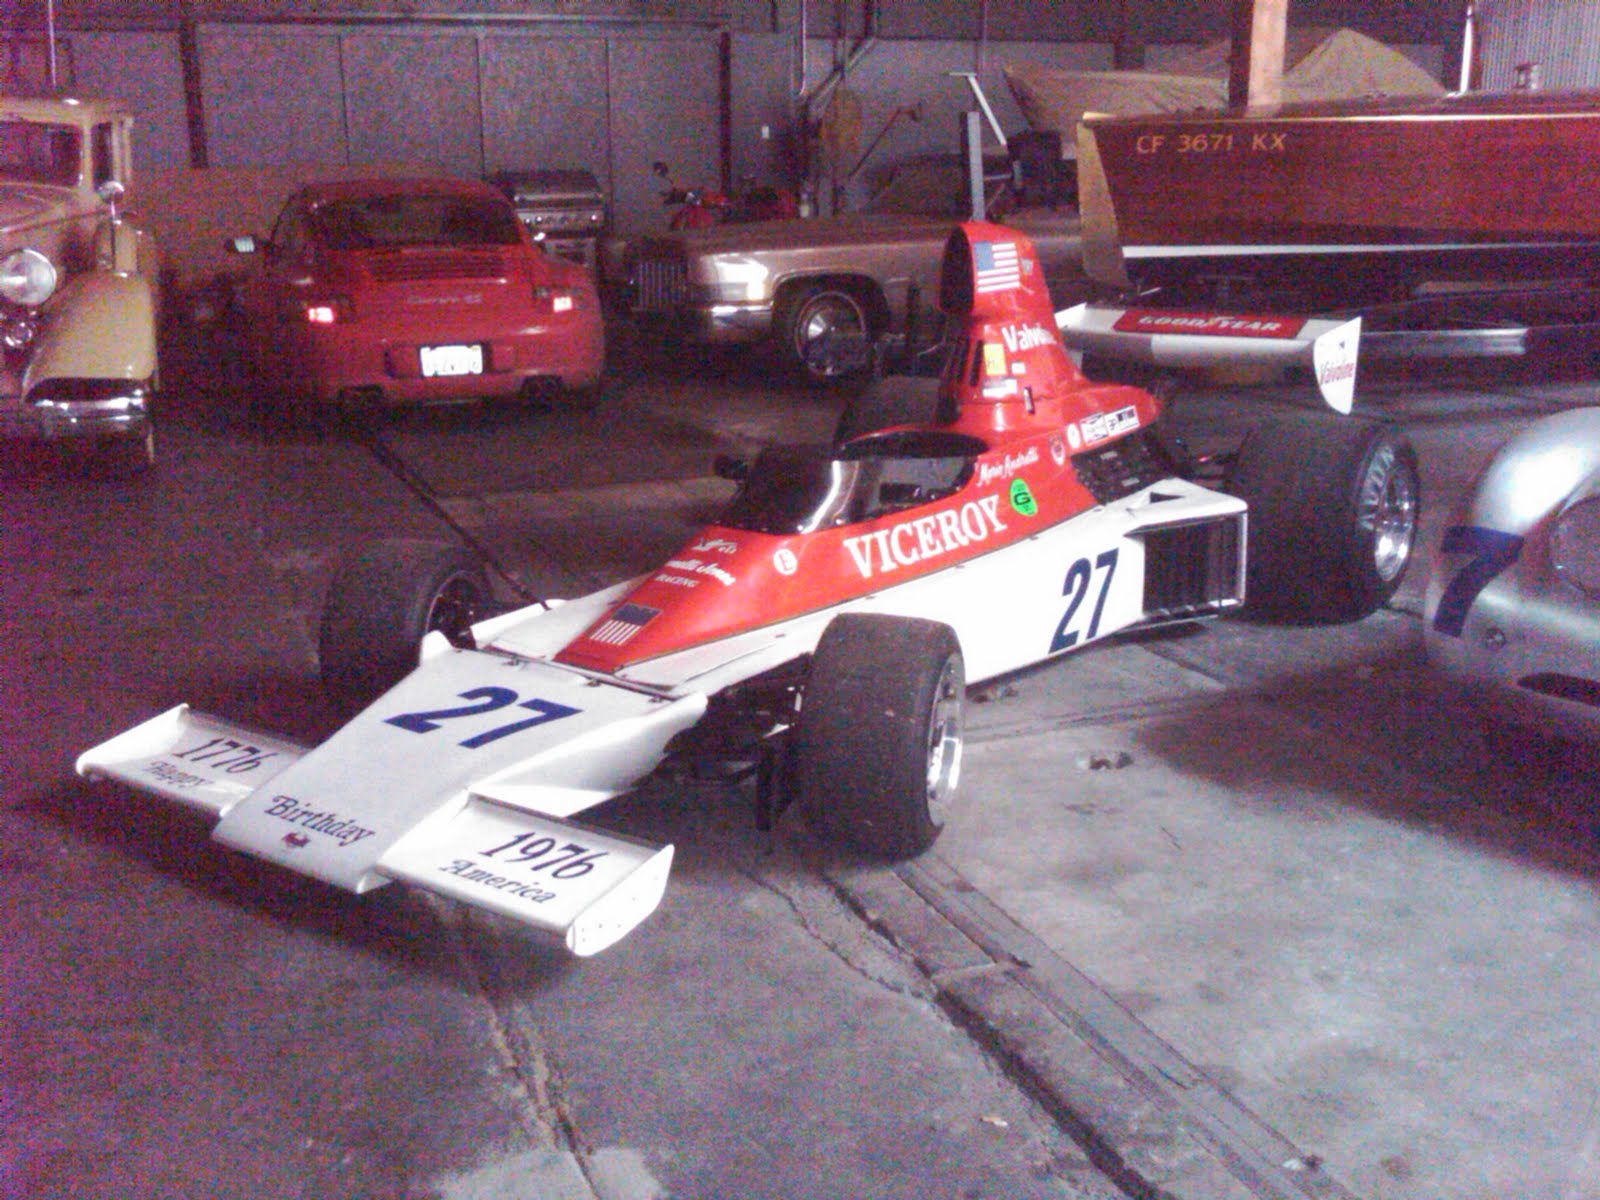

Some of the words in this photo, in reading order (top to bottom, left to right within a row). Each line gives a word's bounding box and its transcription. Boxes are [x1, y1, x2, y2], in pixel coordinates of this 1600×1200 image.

[1136, 134, 1165, 154] CF
[1178, 133, 1233, 153] 3671
[1252, 132, 1287, 151] KX
[1013, 491, 1032, 506] G
[842, 494, 1008, 580] VICEROY
[1048, 547, 1119, 655] 27
[1432, 524, 1526, 638] 7
[381, 686, 585, 749] 27
[172, 738, 279, 774] 1776
[264, 795, 376, 847] Birthday
[477, 832, 610, 879] 1976
[438, 858, 557, 904] America
